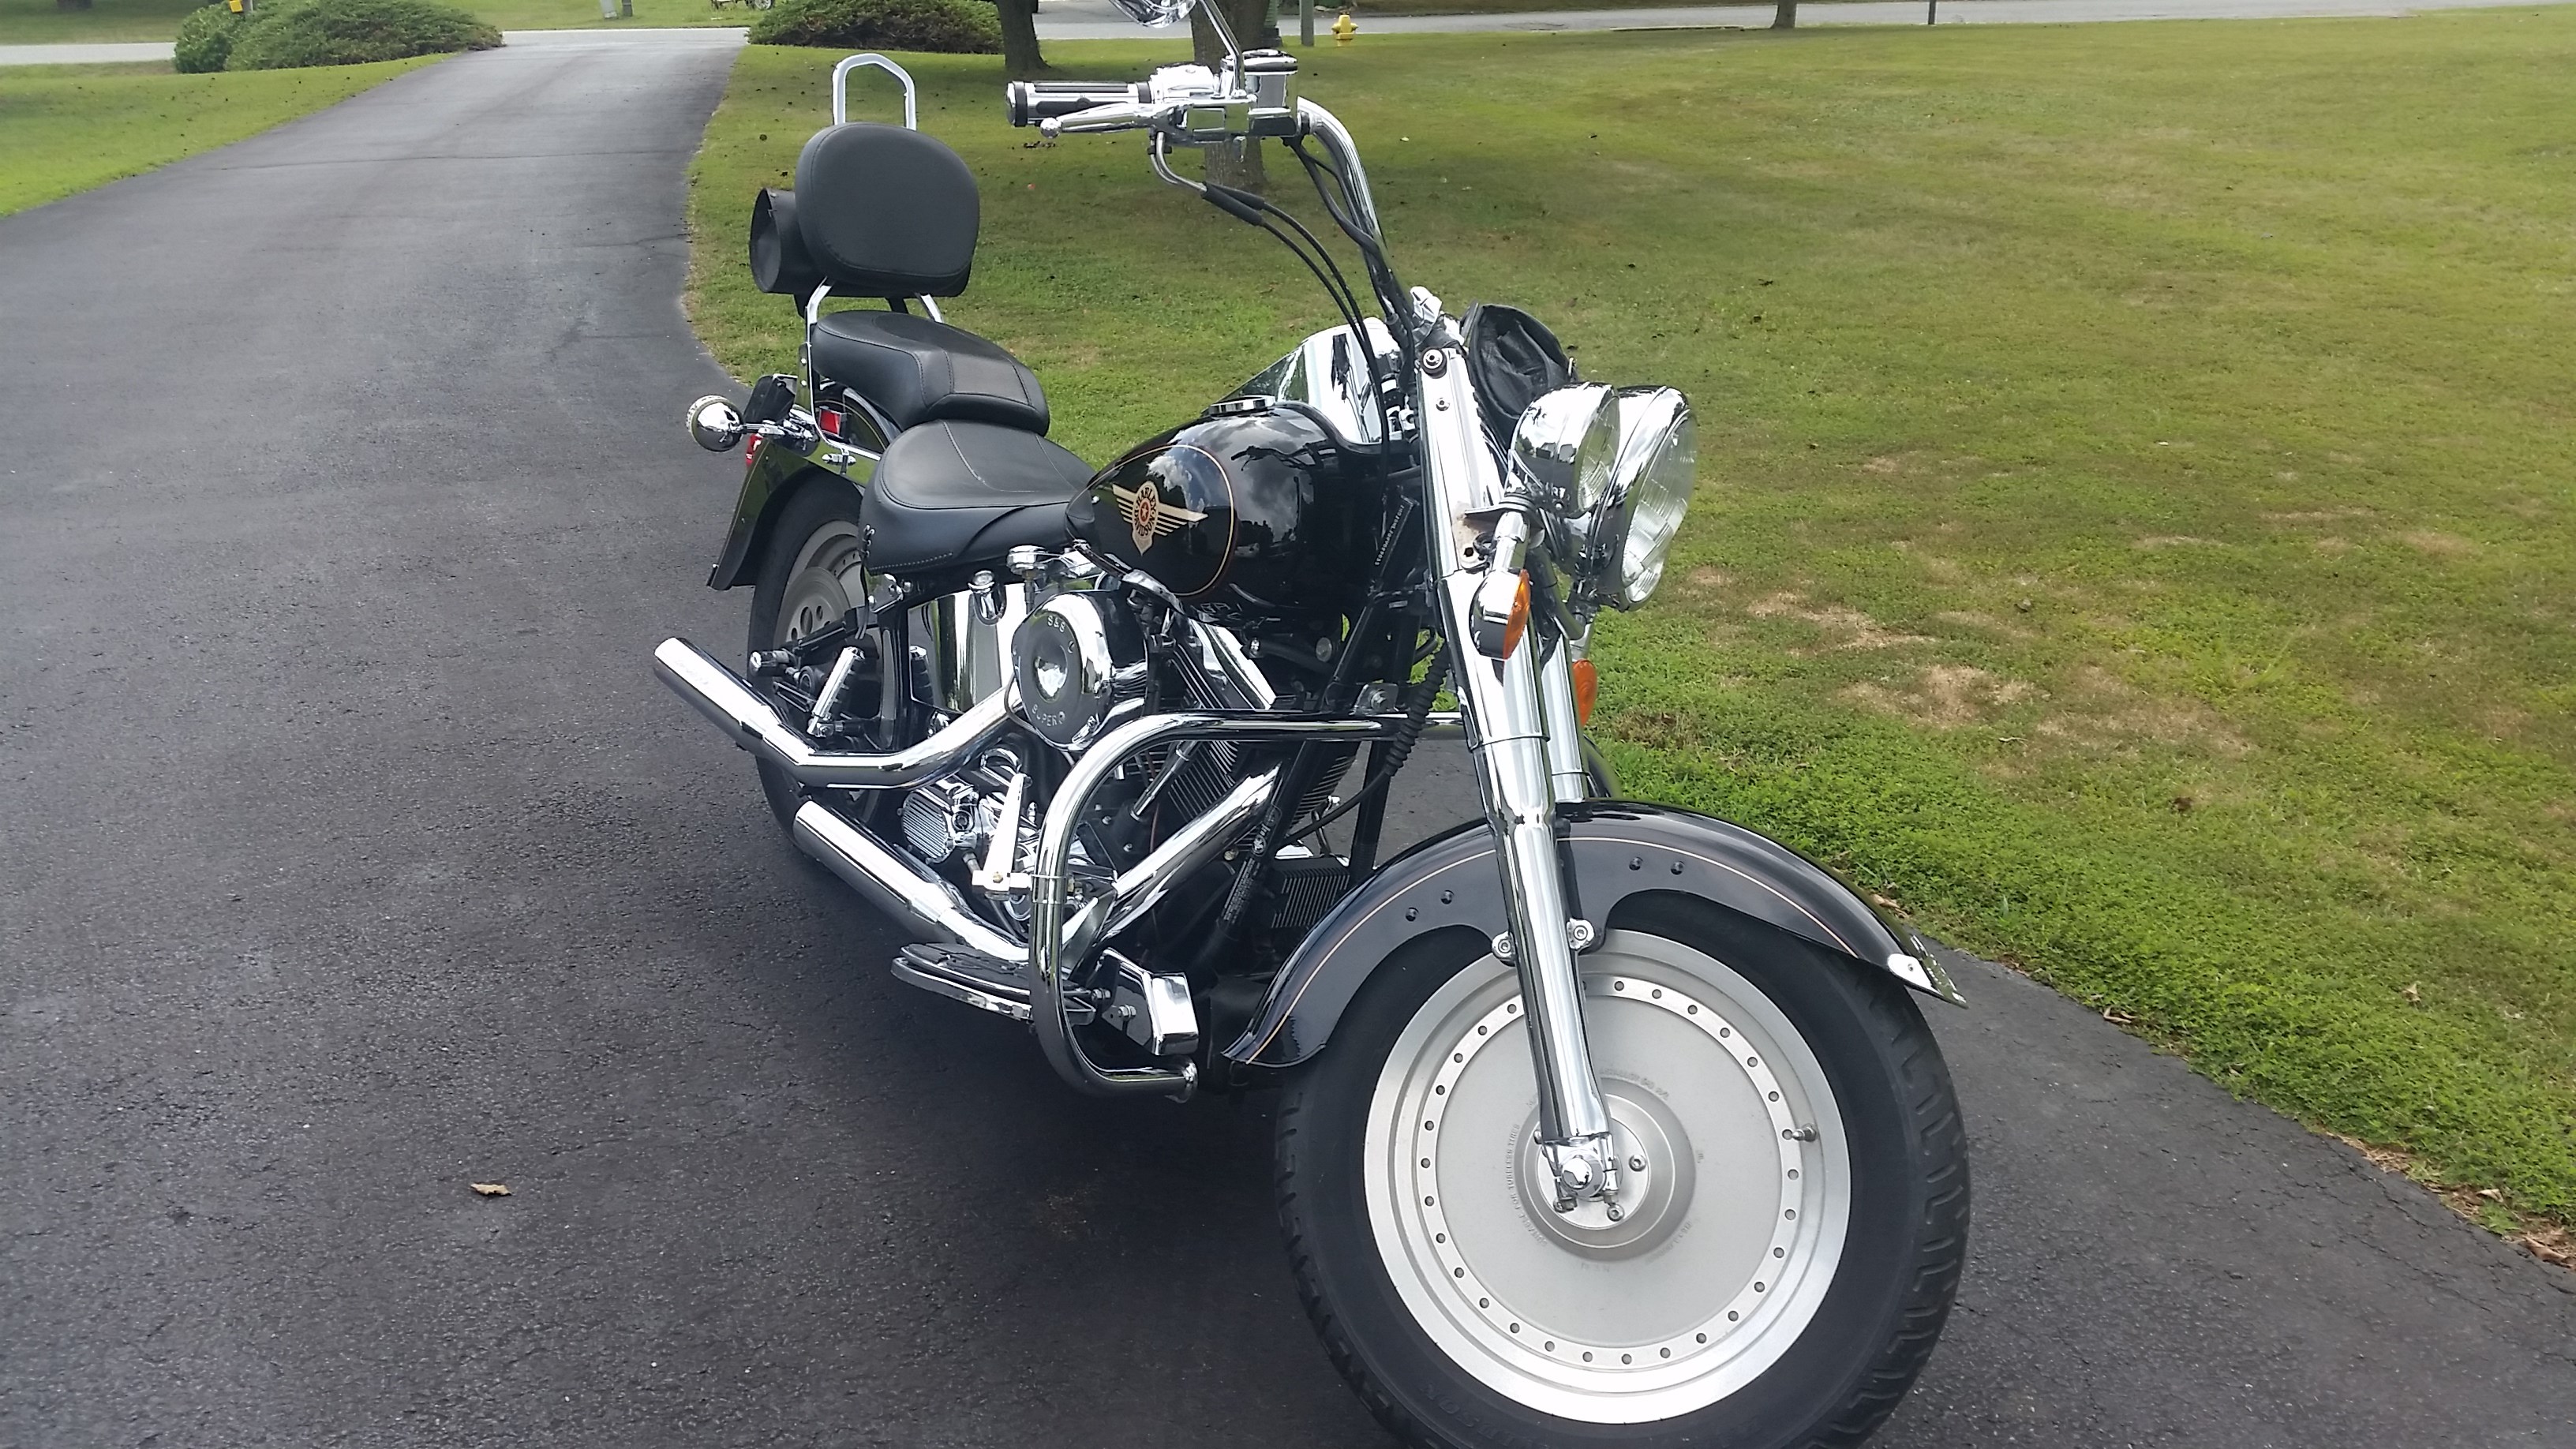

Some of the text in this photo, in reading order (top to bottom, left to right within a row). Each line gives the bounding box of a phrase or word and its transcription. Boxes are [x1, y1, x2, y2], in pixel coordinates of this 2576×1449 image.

[1136, 487, 1156, 511] HARLEY
[1134, 510, 1155, 536] DAVIDSON
[1047, 615, 1065, 633] S&S
[1032, 704, 1058, 726] SUPER
